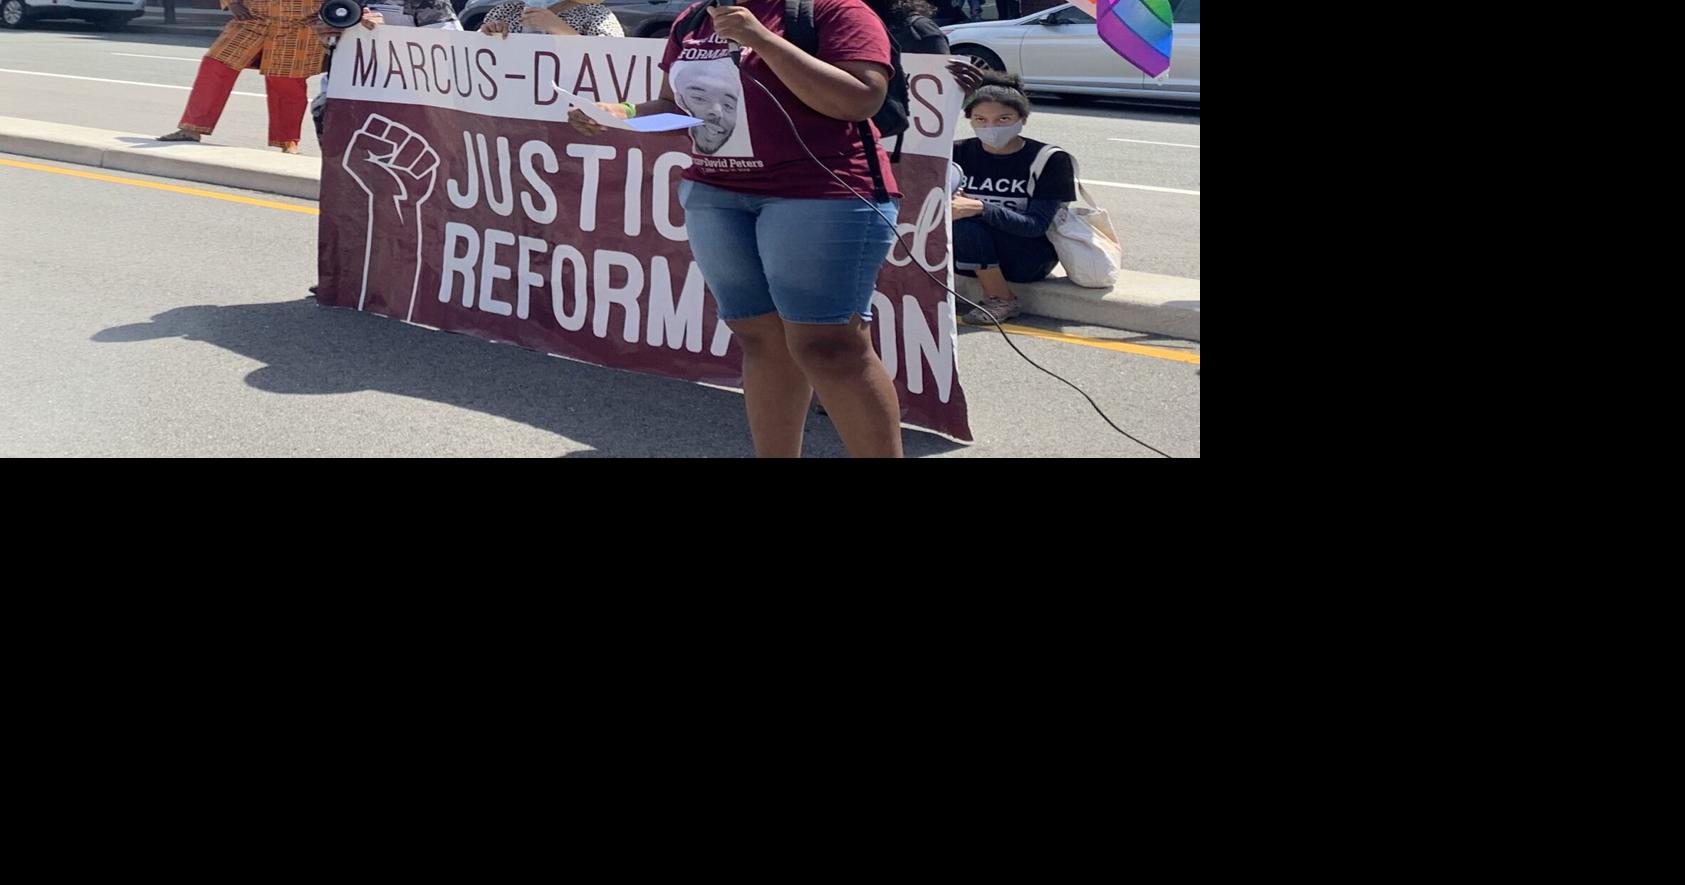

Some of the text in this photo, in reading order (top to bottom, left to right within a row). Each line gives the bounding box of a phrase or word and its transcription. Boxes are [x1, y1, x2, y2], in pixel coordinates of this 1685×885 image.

[352, 37, 651, 106] MARCUS-DAVI
[446, 130, 692, 242] JUSTIC
[960, 175, 1026, 194] BLACK
